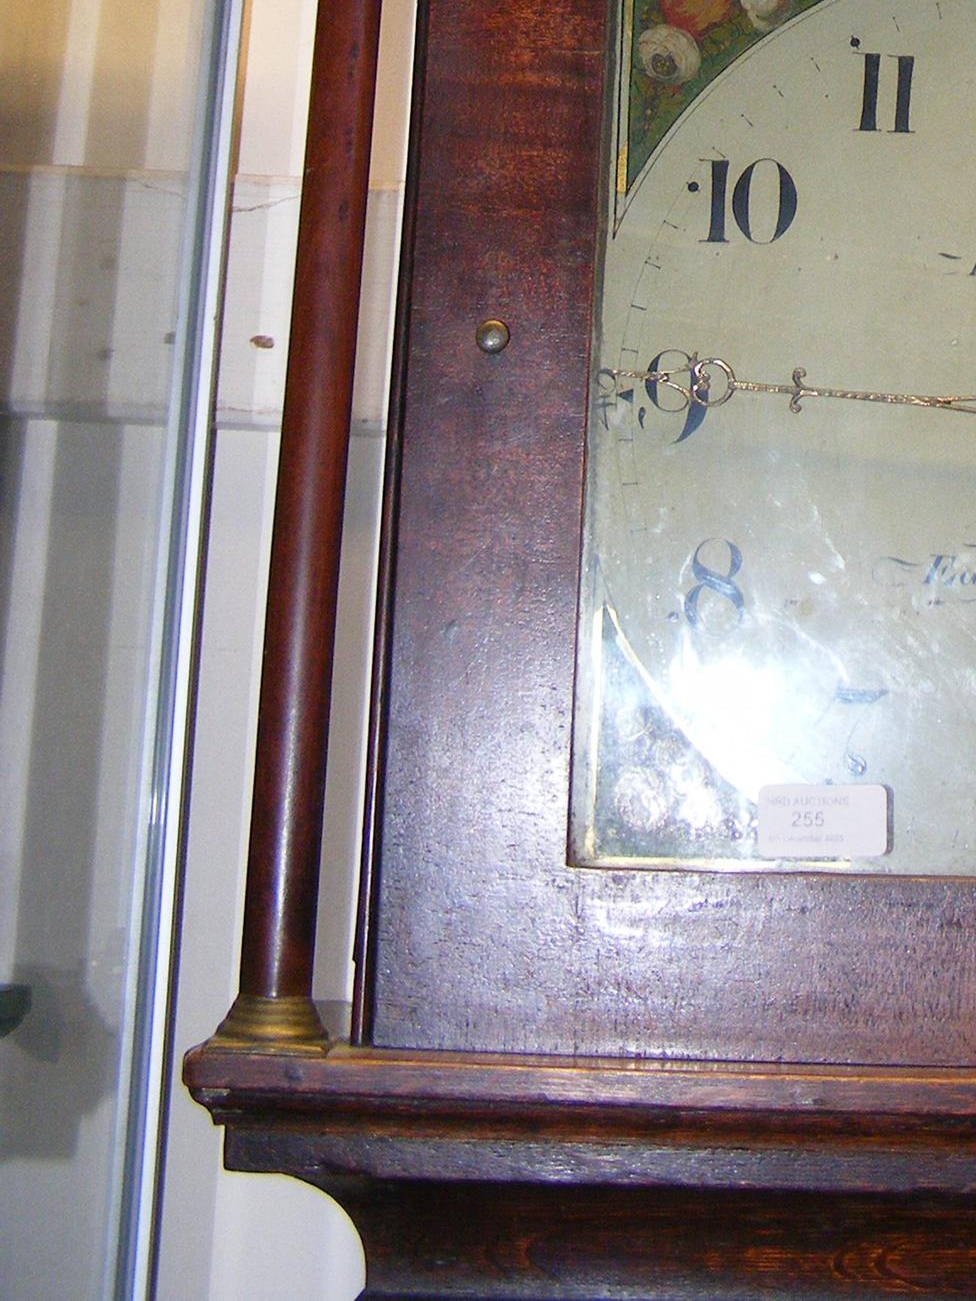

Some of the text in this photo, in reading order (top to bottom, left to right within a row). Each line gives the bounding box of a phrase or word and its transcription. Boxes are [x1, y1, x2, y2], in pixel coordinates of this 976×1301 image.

[852, 52, 917, 133] 11
[699, 157, 798, 245] 10
[638, 348, 710, 445] 9
[683, 536, 745, 637] 8
[791, 810, 825, 828] 255
